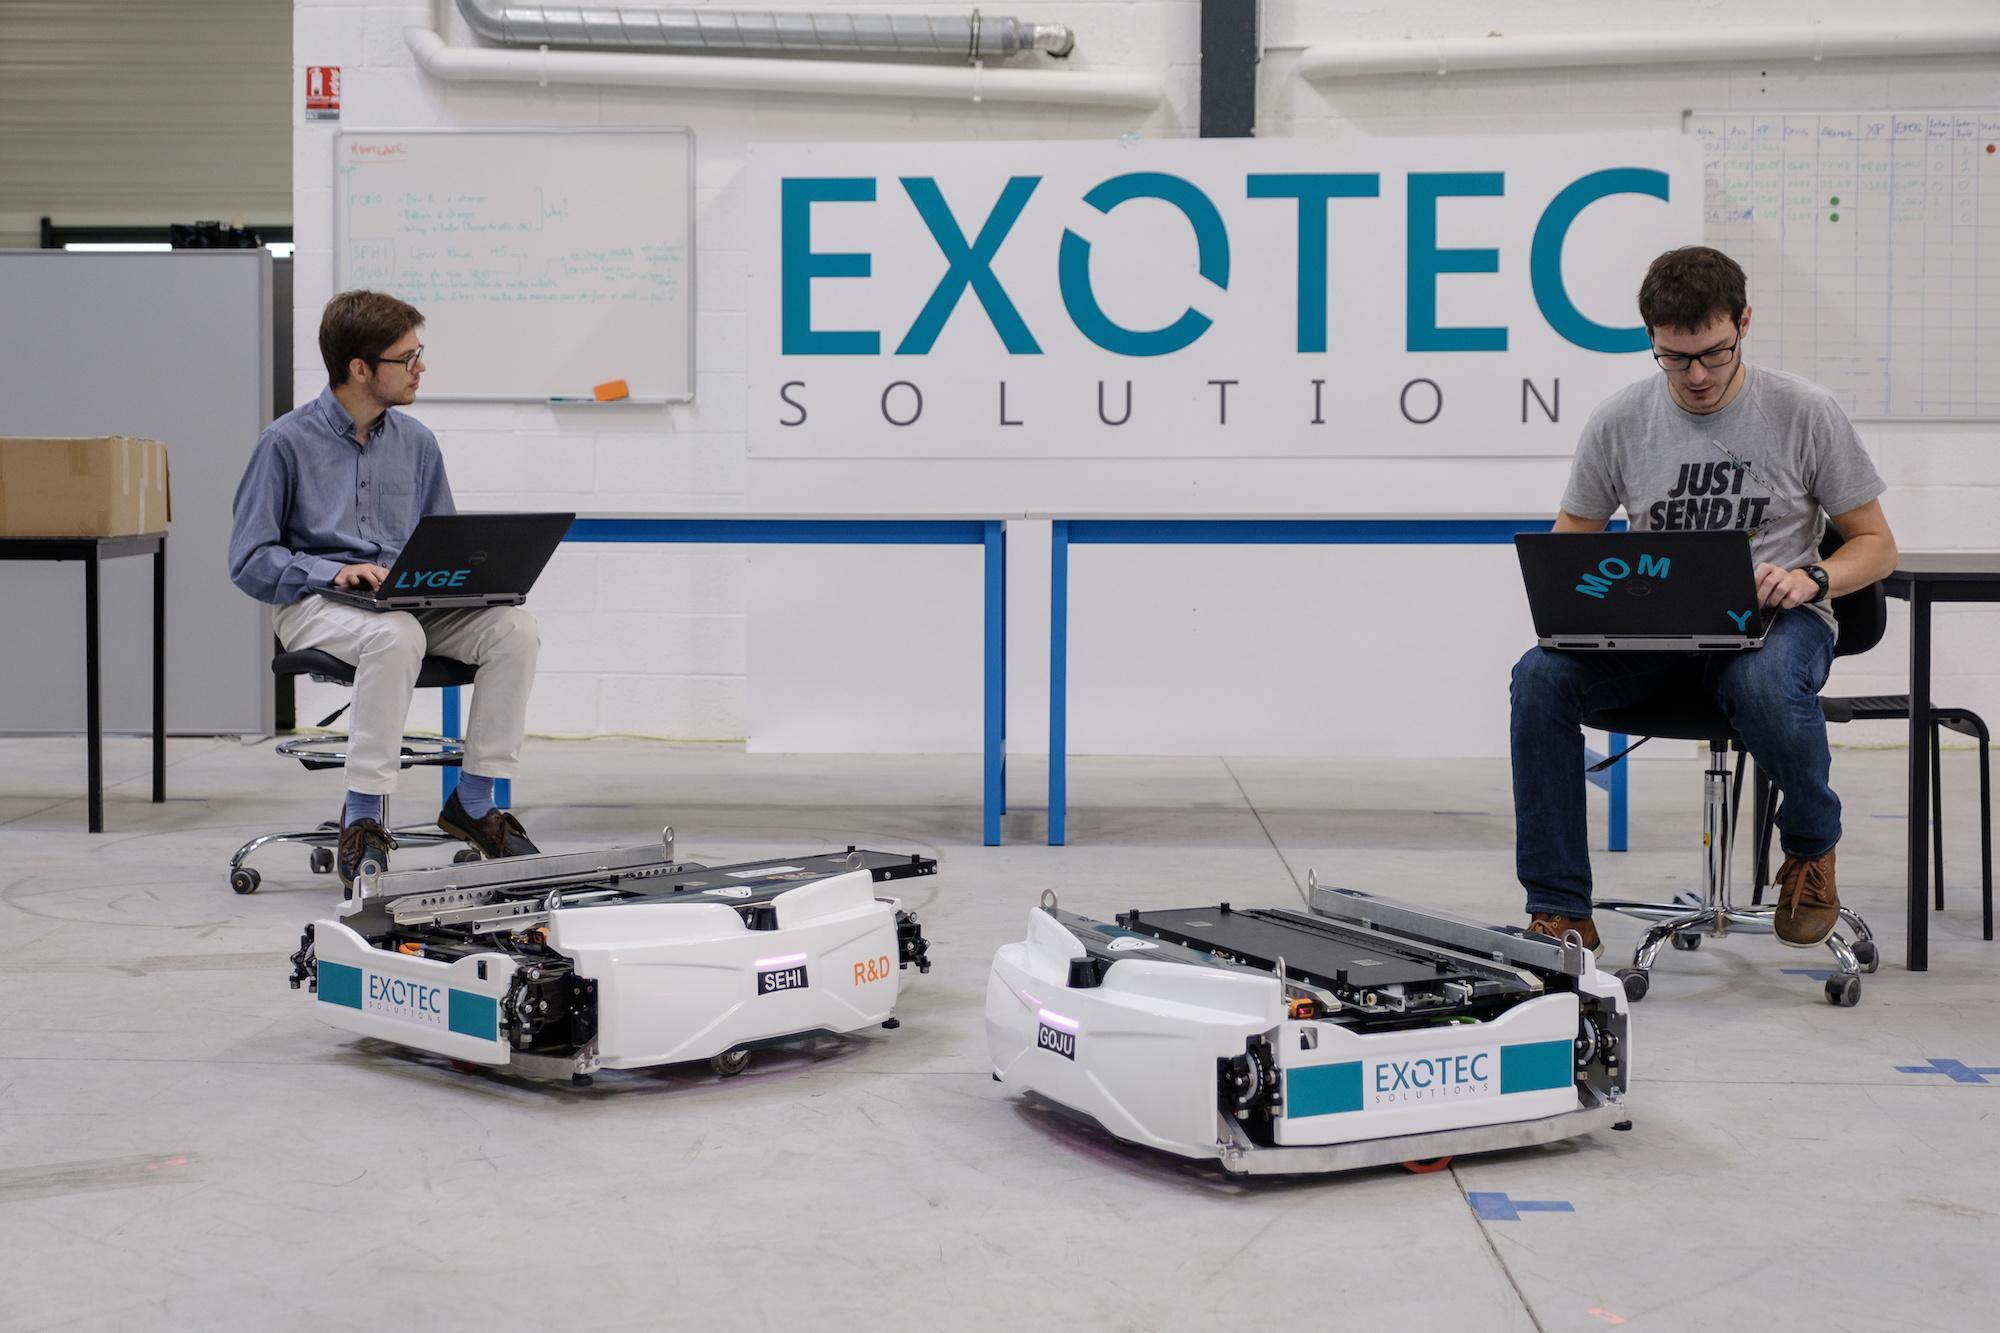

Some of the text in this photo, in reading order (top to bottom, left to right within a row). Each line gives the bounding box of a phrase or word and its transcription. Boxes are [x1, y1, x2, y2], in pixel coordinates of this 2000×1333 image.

[781, 167, 1670, 356] EXOTEC
[1668, 461, 1751, 498] JUST
[1650, 497, 1771, 530] SEND IT
[395, 569, 471, 589] LYGE
[765, 969, 801, 992] SEHI
[853, 956, 890, 986] R&D
[370, 975, 441, 1014] EXOTEC
[369, 1000, 441, 1024] SOLUTIONS
[1039, 1026, 1073, 1055] GOJU
[1375, 1053, 1489, 1093] EXOTEC
[1375, 1083, 1489, 1103] SOLUTIONS
